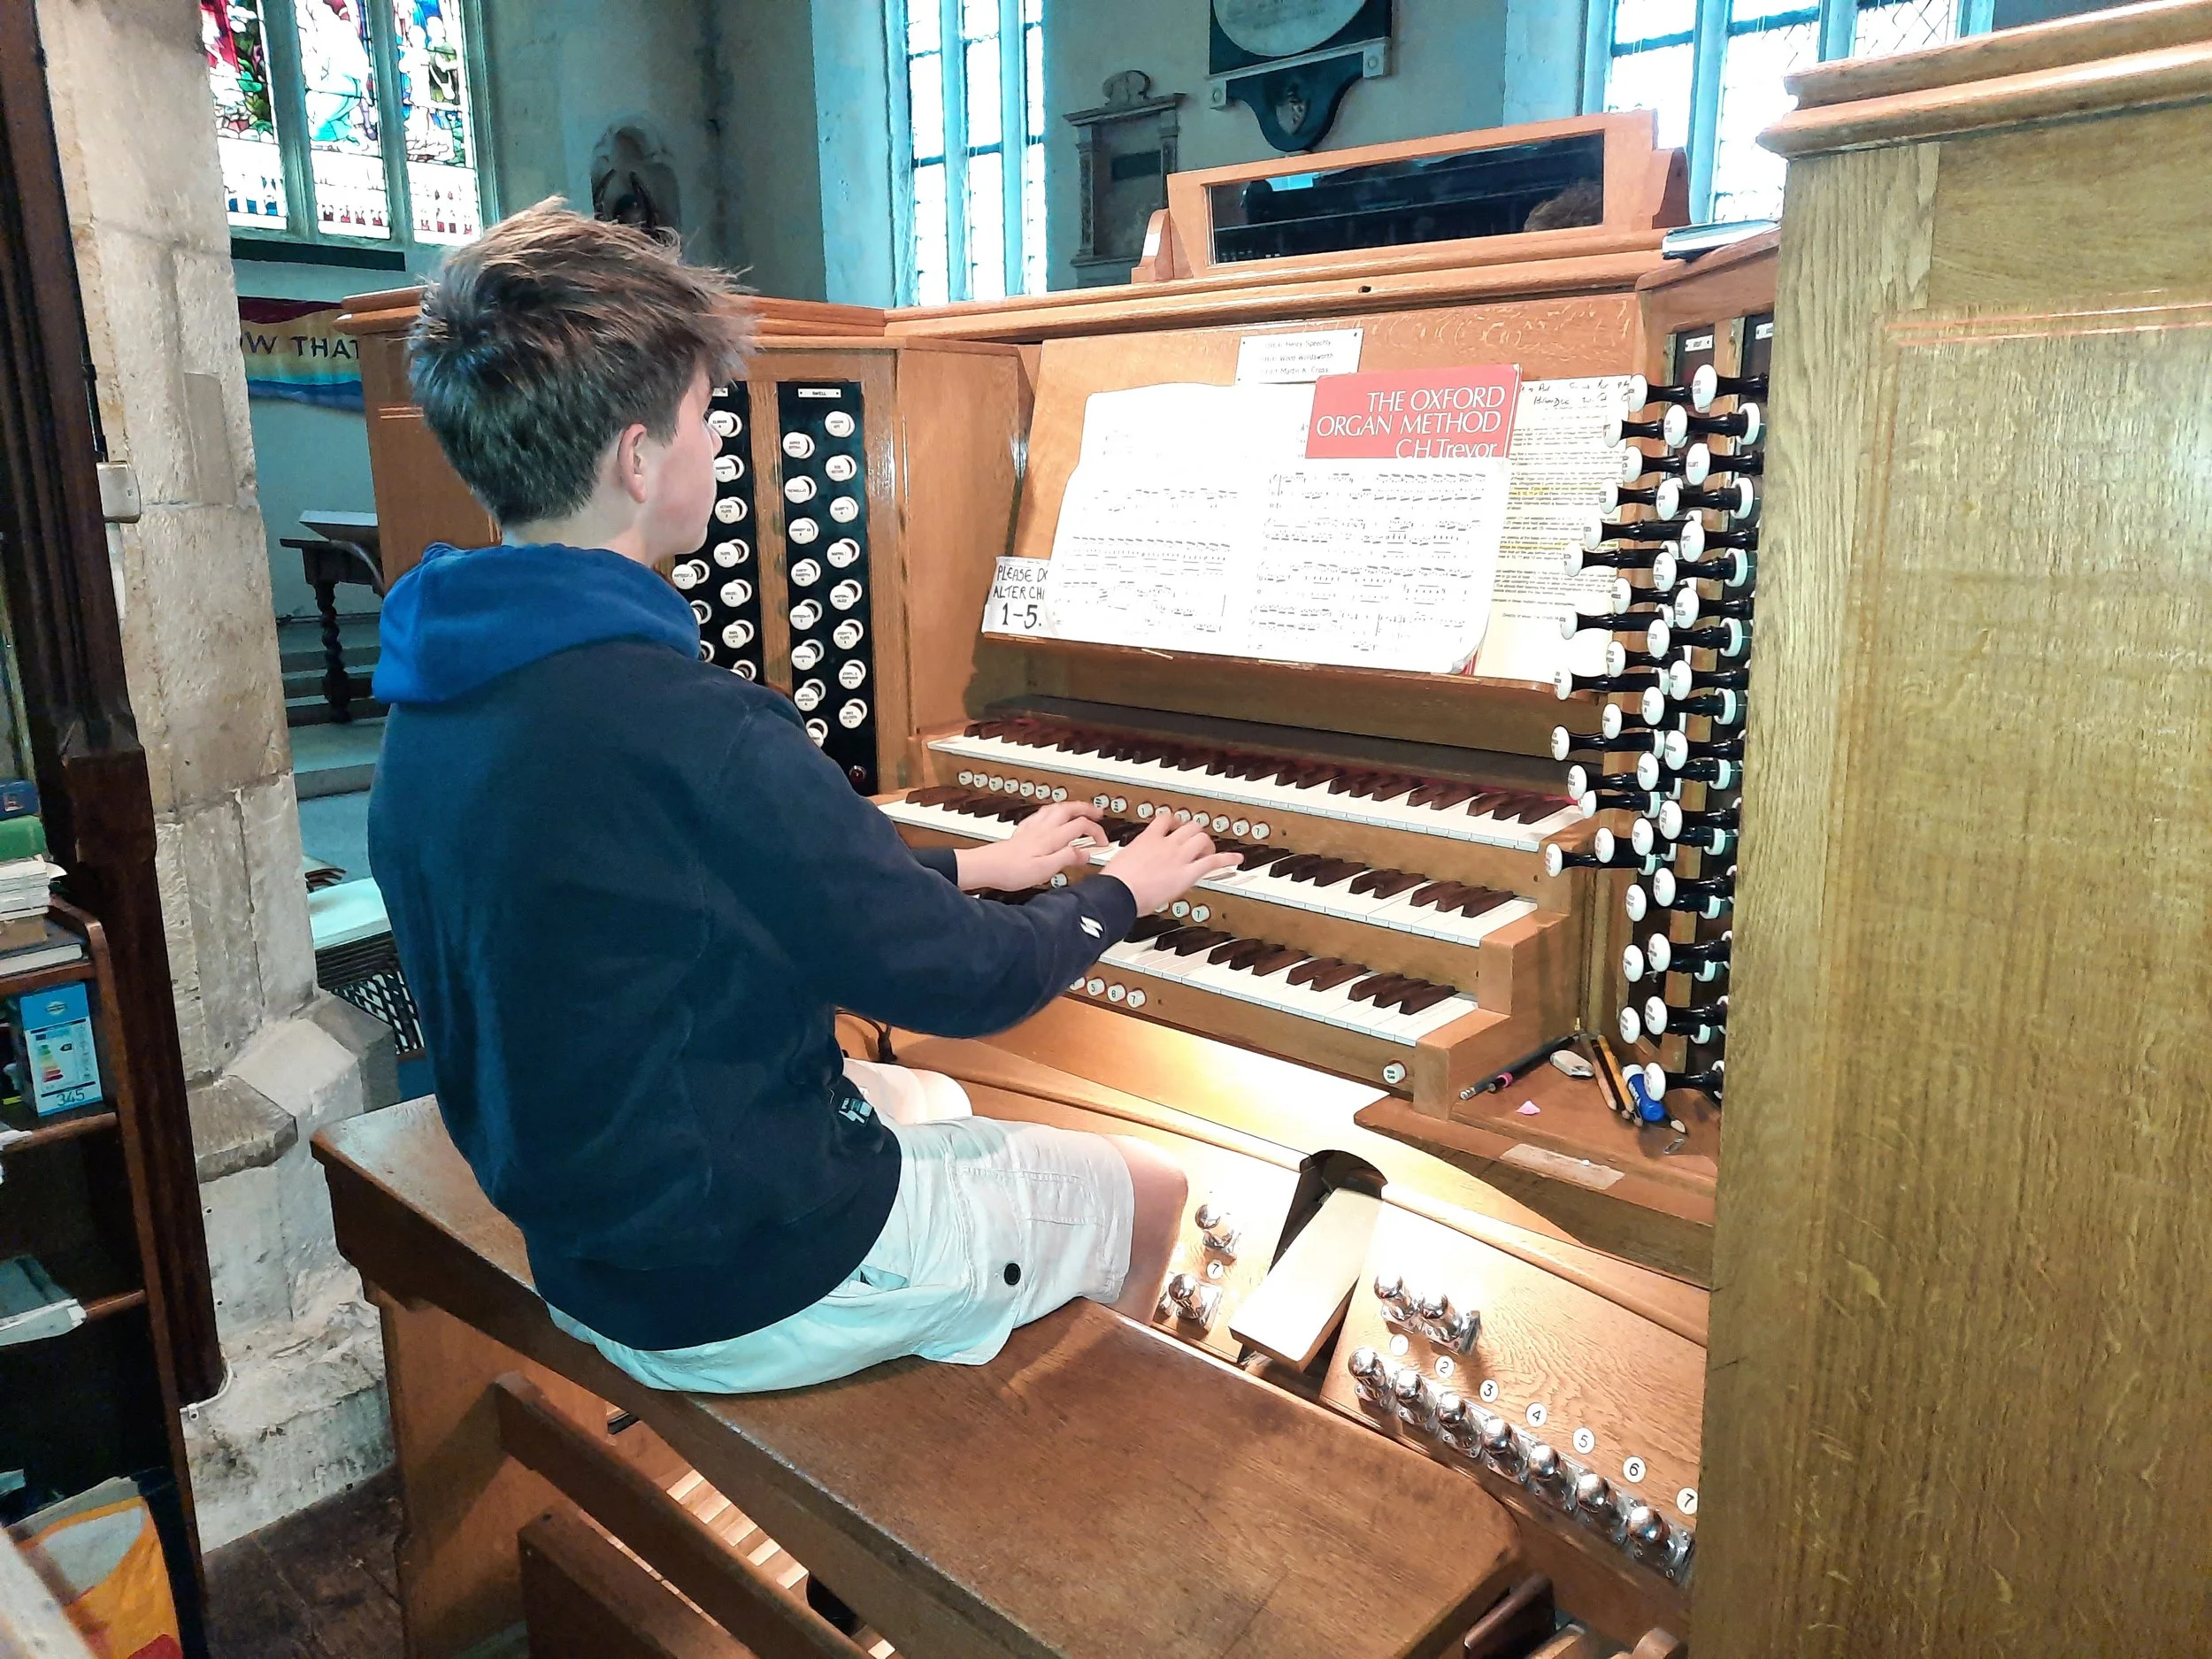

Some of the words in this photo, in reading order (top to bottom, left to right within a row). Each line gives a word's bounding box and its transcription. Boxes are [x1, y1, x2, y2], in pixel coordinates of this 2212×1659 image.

[239, 330, 278, 354] W
[1366, 390, 1407, 412] THE
[1409, 386, 1506, 412] OXFORD
[1317, 414, 1393, 437] ORGAN
[1399, 411, 1502, 435] METHOD
[996, 565, 1033, 583] PLEASE
[993, 585, 1026, 600] ALTER
[1028, 586, 1045, 601] CH
[1213, 1263, 1220, 1275] 7
[1440, 1361, 1449, 1374] 2
[1483, 1383, 1494, 1397] 3
[1532, 1409, 1541, 1422] 4
[1578, 1434, 1589, 1448] 5
[1629, 1463, 1640, 1477] 6
[1684, 1493, 1695, 1508] 7
